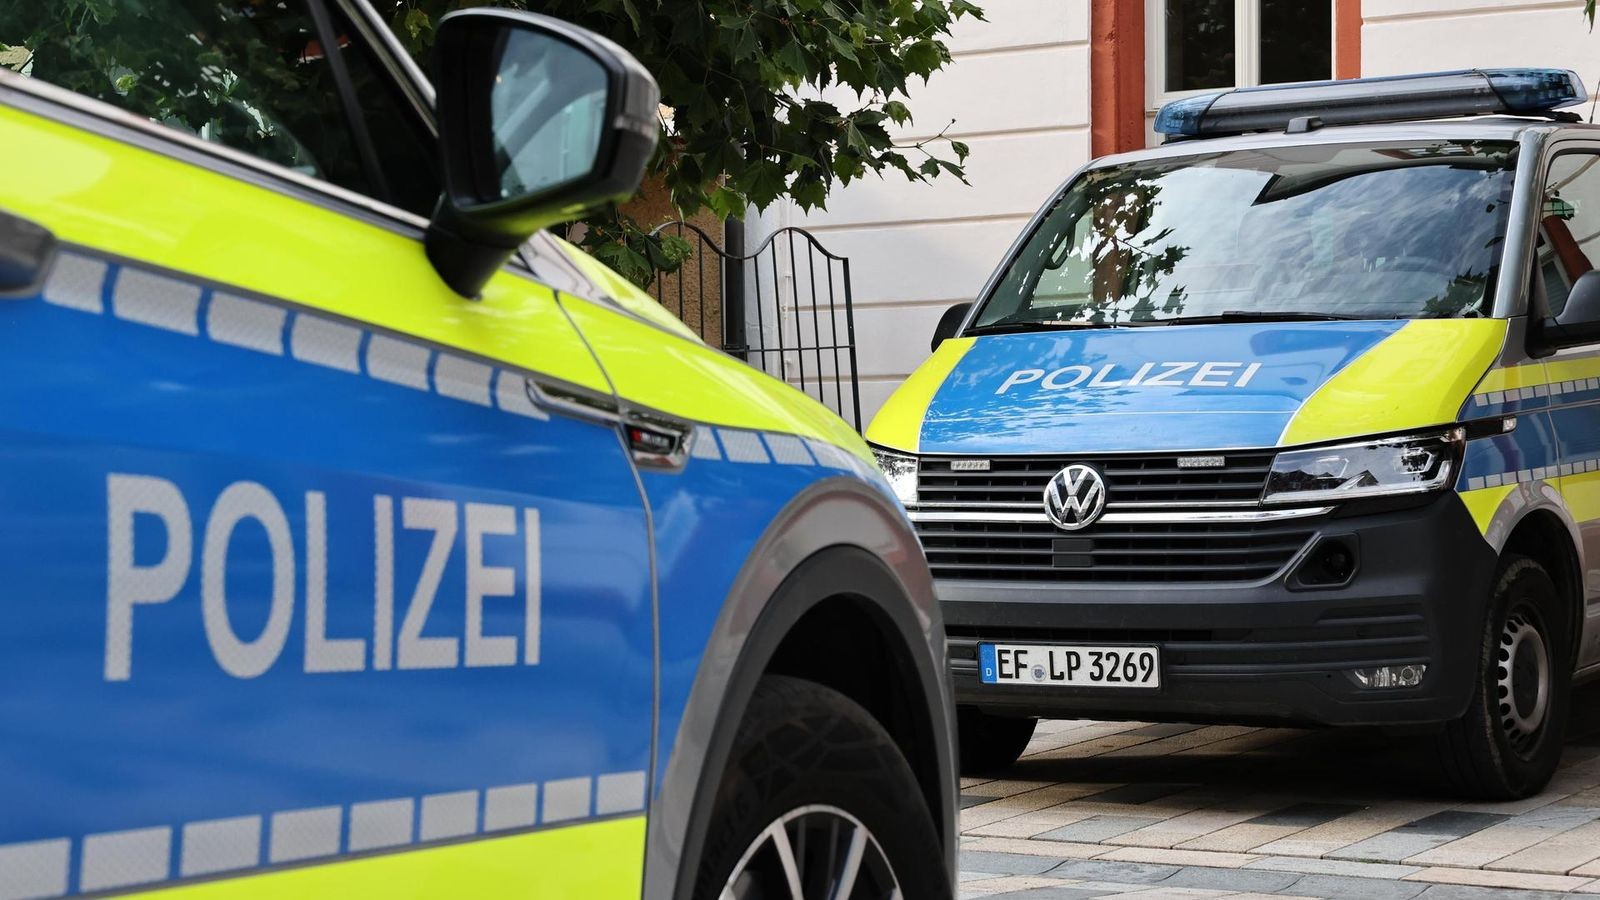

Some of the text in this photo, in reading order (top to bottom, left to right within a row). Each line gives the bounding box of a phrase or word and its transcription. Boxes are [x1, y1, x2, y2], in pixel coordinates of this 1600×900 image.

[995, 362, 1262, 394] POLIZEI
[1044, 464, 1106, 530] VW
[104, 472, 542, 682] POLIZEI
[986, 667, 993, 677] D
[997, 649, 1155, 682] EF LP 3269
